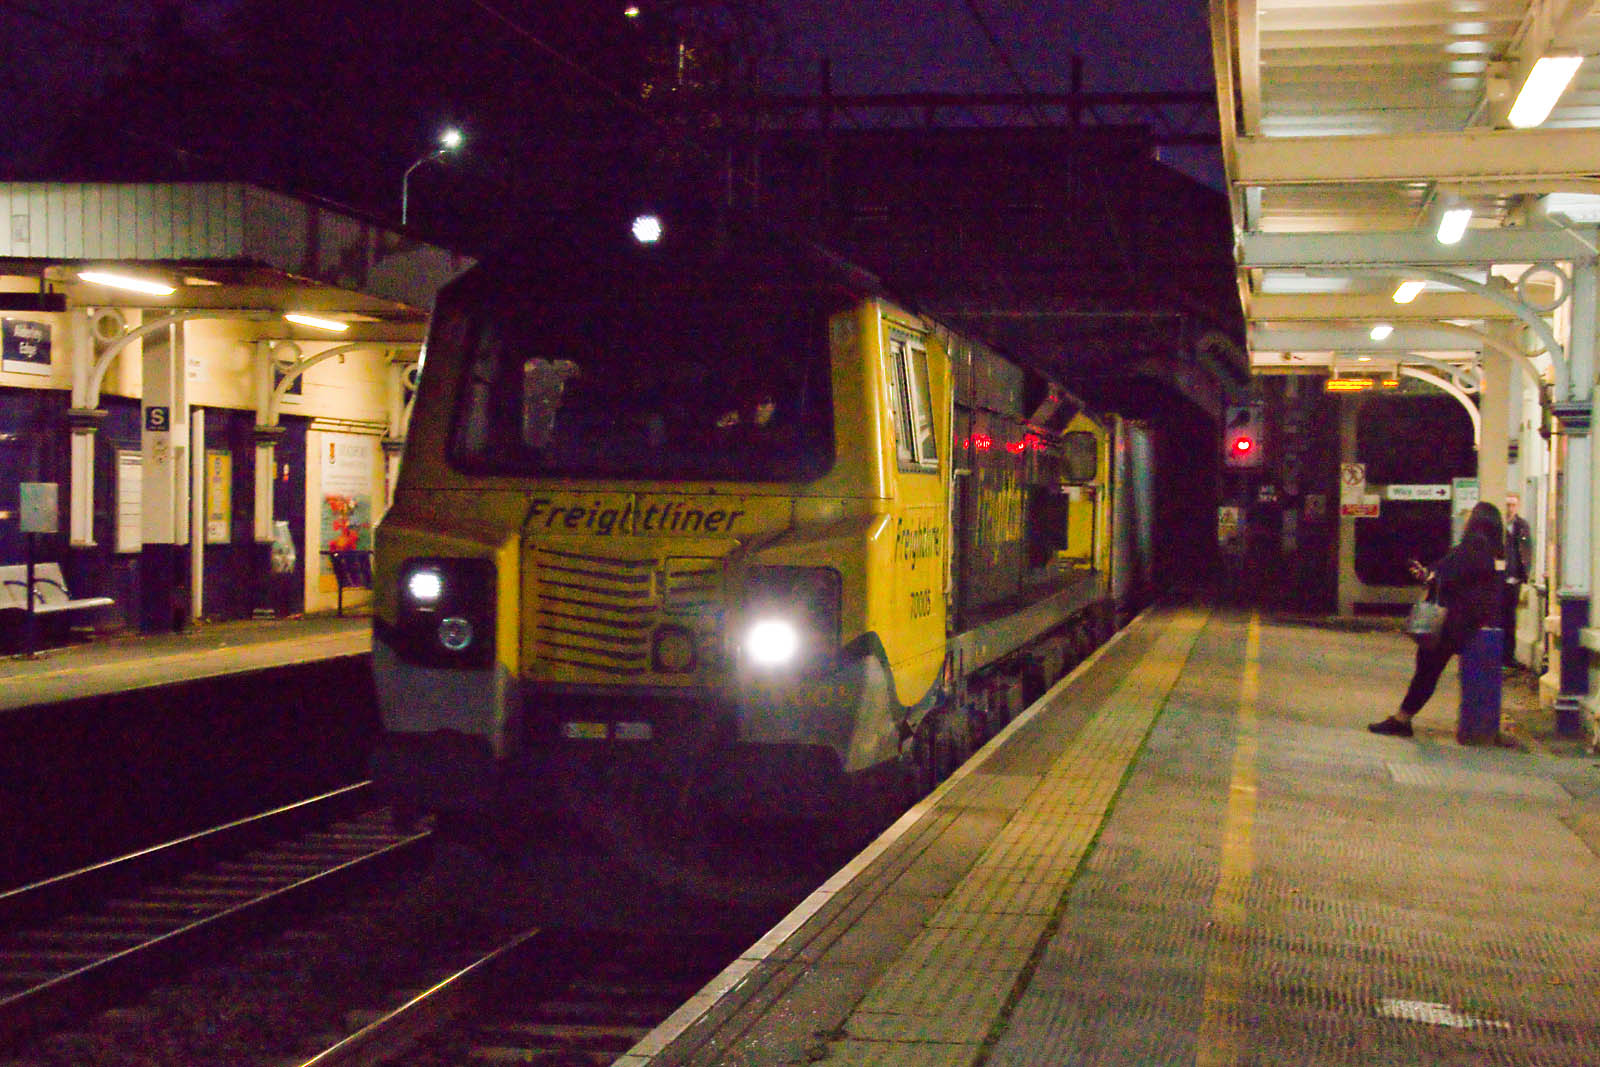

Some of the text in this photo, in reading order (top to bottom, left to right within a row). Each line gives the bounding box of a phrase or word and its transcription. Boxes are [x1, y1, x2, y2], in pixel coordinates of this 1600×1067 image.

[151, 407, 165, 426] S
[1393, 487, 1412, 497] Way
[524, 497, 744, 537] Freightliner
